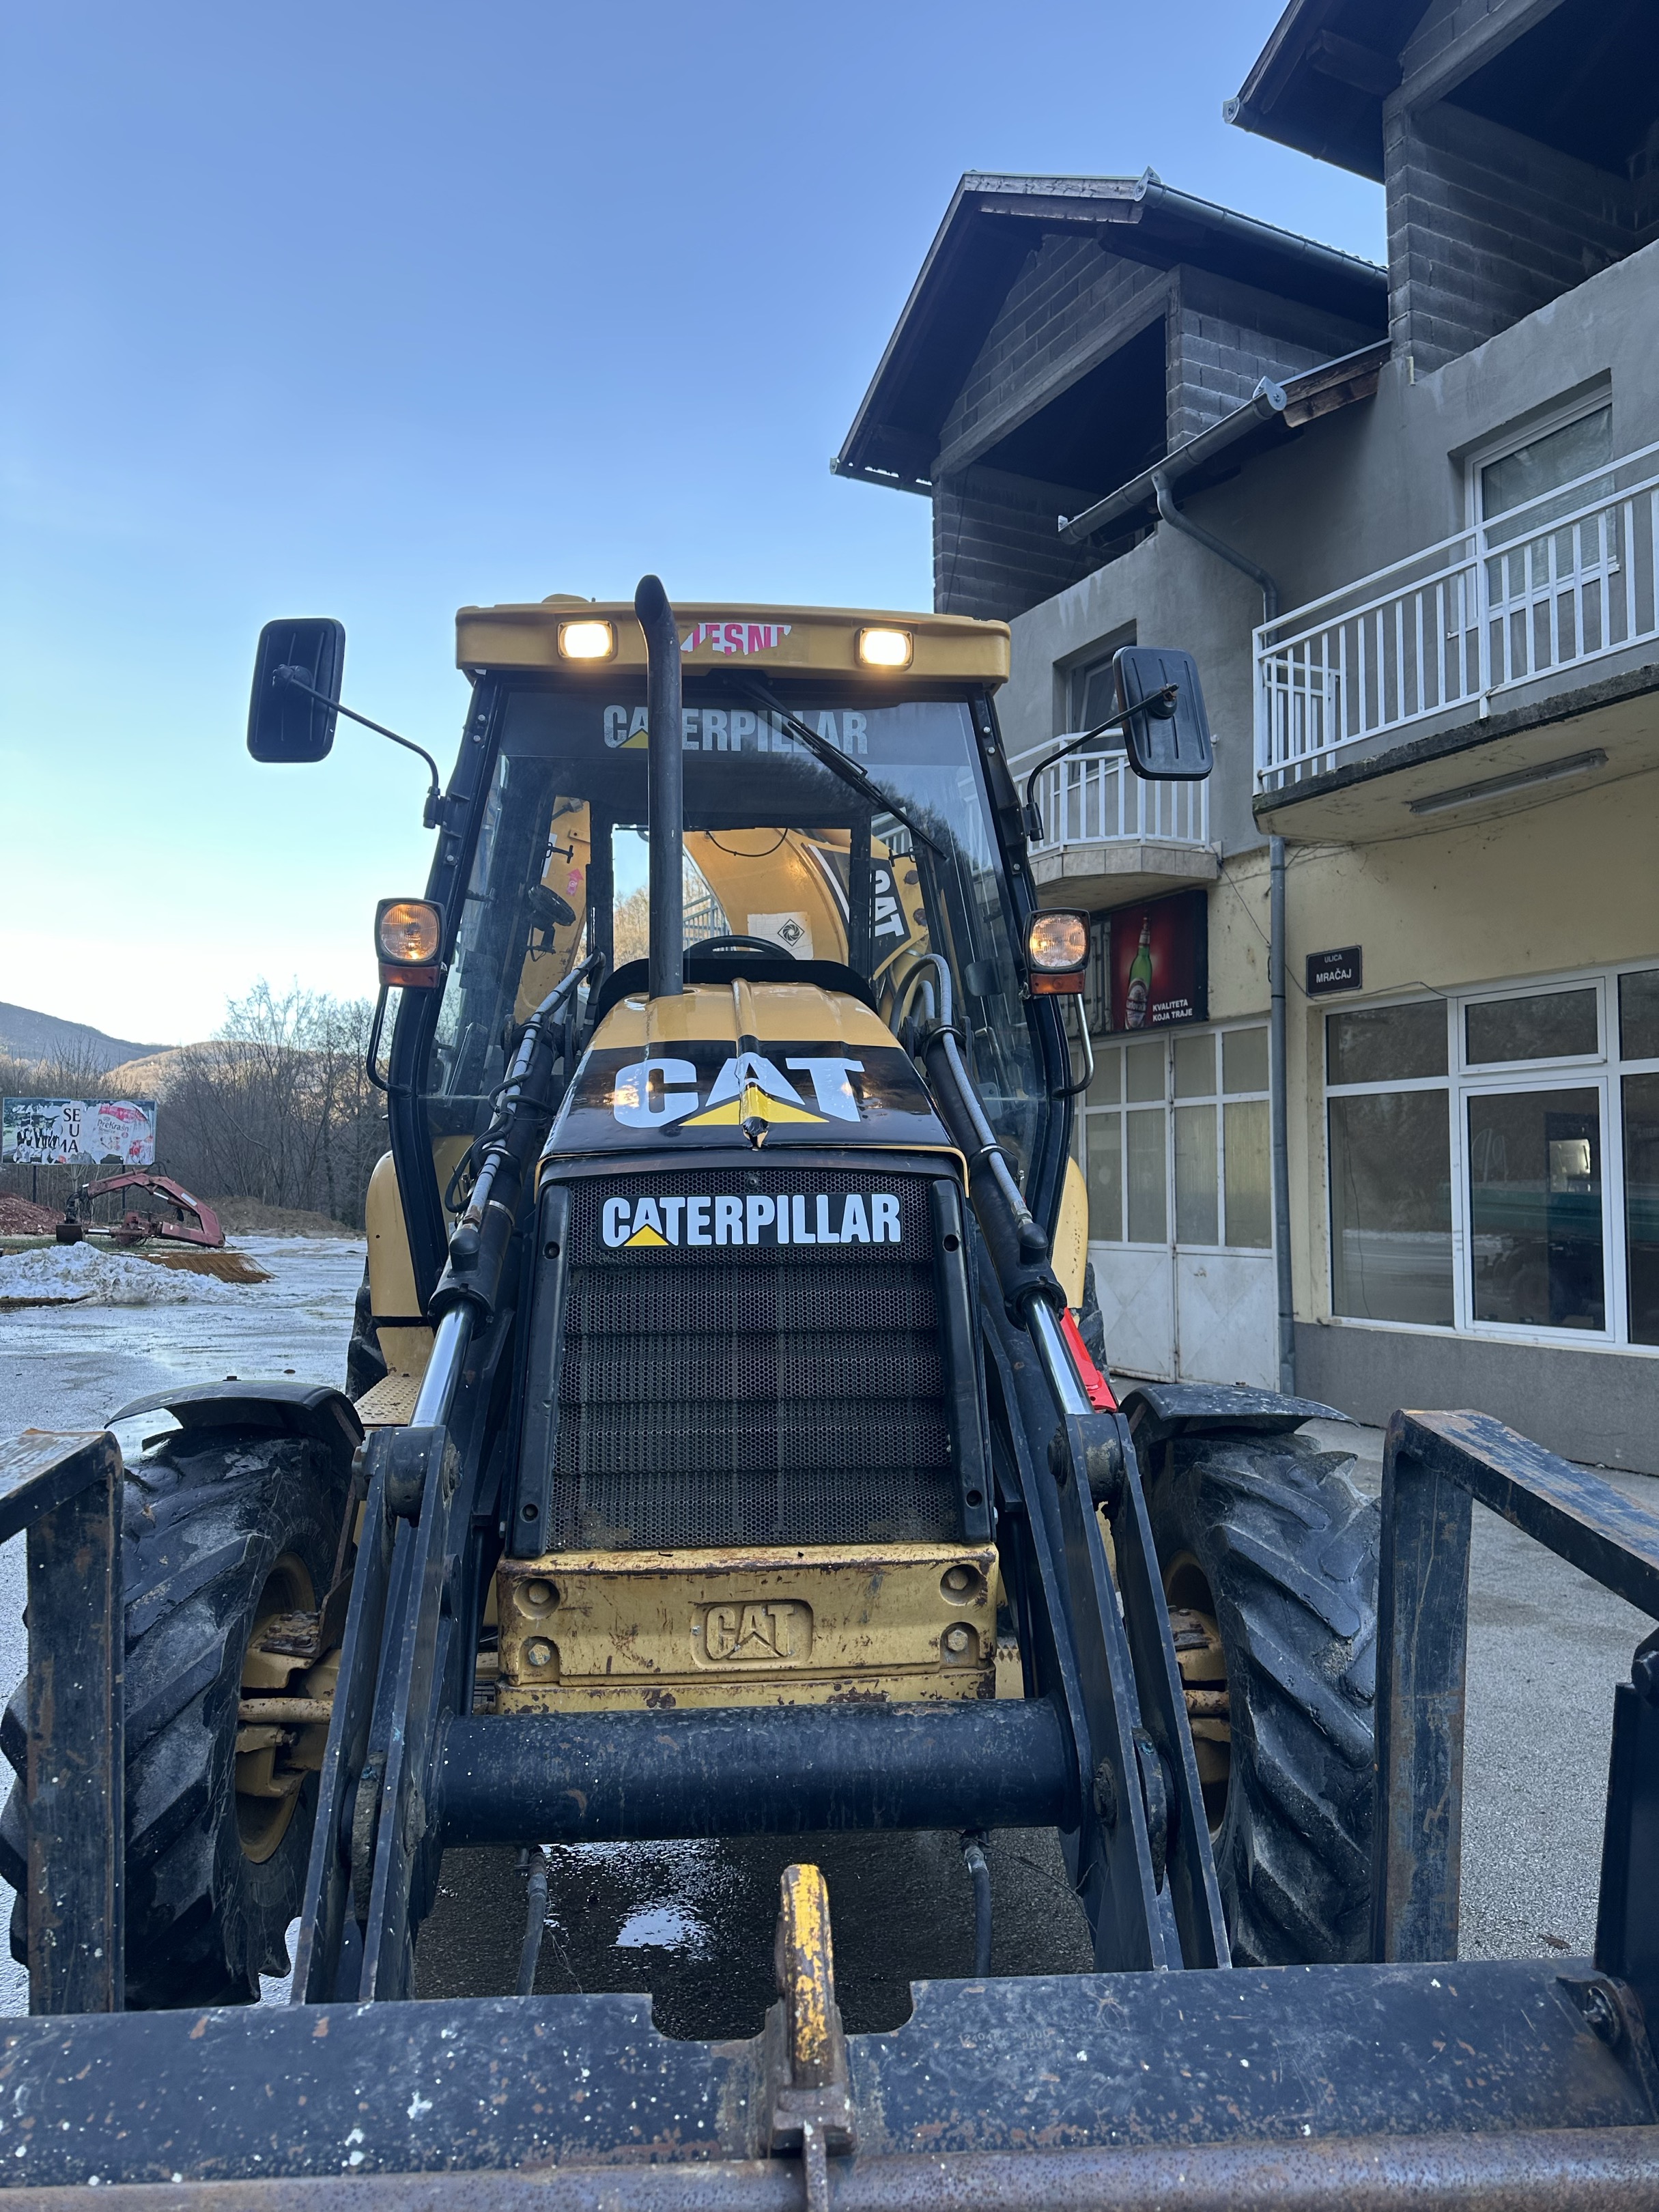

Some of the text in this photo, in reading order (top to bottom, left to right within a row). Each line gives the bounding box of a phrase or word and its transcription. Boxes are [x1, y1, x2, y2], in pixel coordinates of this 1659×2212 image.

[604, 705, 868, 754] CAERPILLAR
[1324, 954, 1342, 963] ULICA
[1316, 967, 1352, 983] MRAČAJ
[1152, 999, 1189, 1012] KVALITETA
[1152, 1008, 1193, 1022] KOJA TRAJE
[614, 1052, 865, 1129] CAT
[63, 1108, 81, 1122] SE
[602, 1193, 901, 1248] CATERPILLAR
[706, 1603, 797, 1660] CAT
